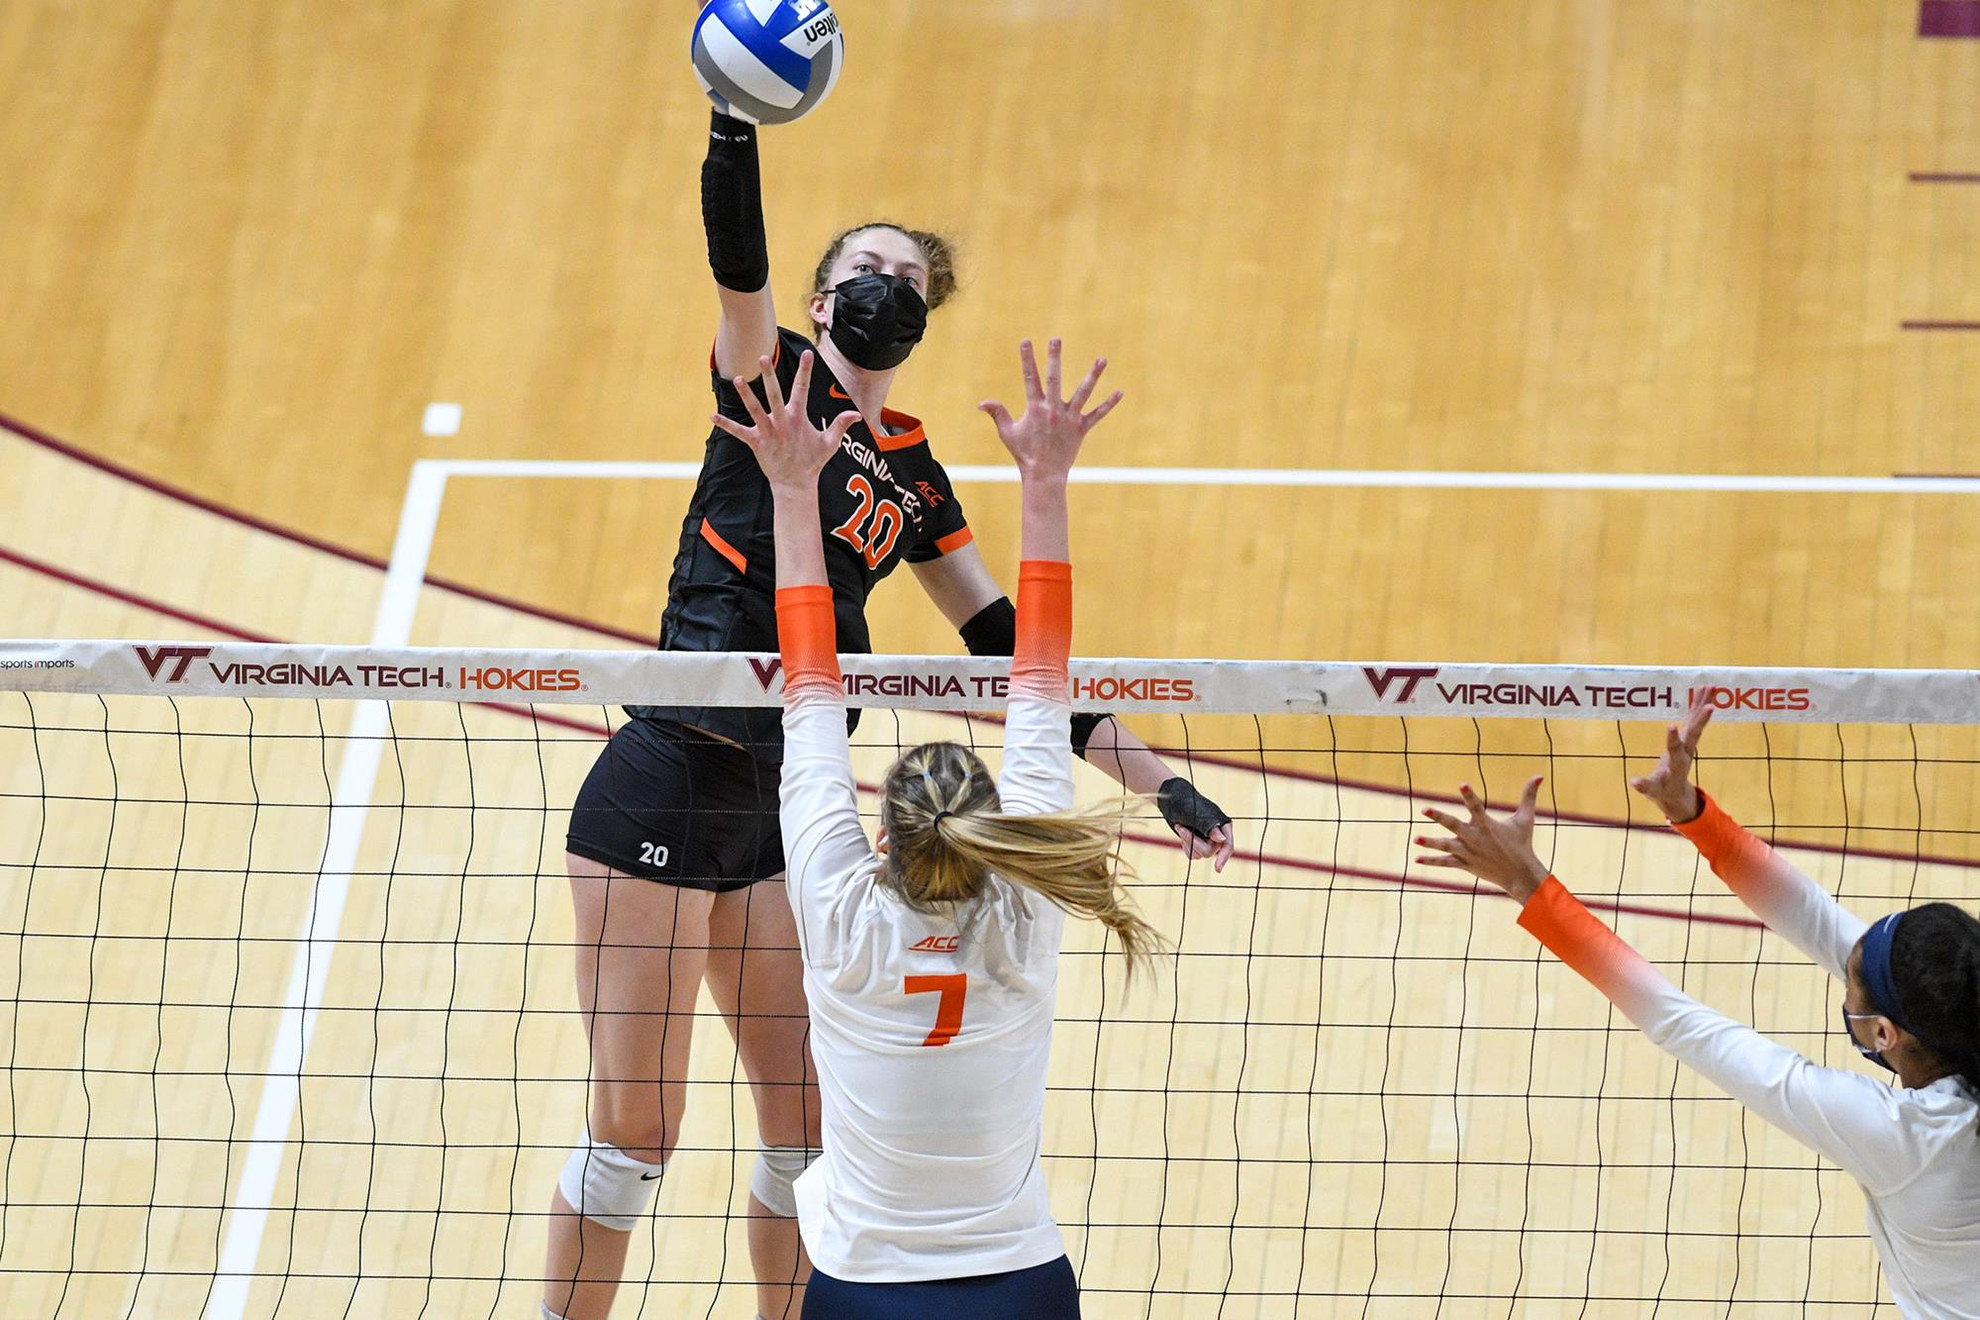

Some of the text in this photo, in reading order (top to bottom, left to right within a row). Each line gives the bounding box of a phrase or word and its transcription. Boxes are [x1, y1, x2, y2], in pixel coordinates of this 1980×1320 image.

[915, 481, 945, 508] ACC
[830, 473, 904, 571] 20
[0, 659, 75, 670] sports imports
[132, 645, 581, 692] VT VIRGINIA TECH HOKIES
[745, 656, 787, 694] V
[970, 676, 1011, 698] TE
[1073, 677, 1194, 701] HOKIES
[1361, 666, 1442, 704] VT
[1436, 683, 1581, 707] VIRGINIA
[1585, 685, 1672, 708] TECH
[639, 841, 669, 867] 20
[908, 936, 961, 953] ACC
[904, 973, 968, 1047] 7
